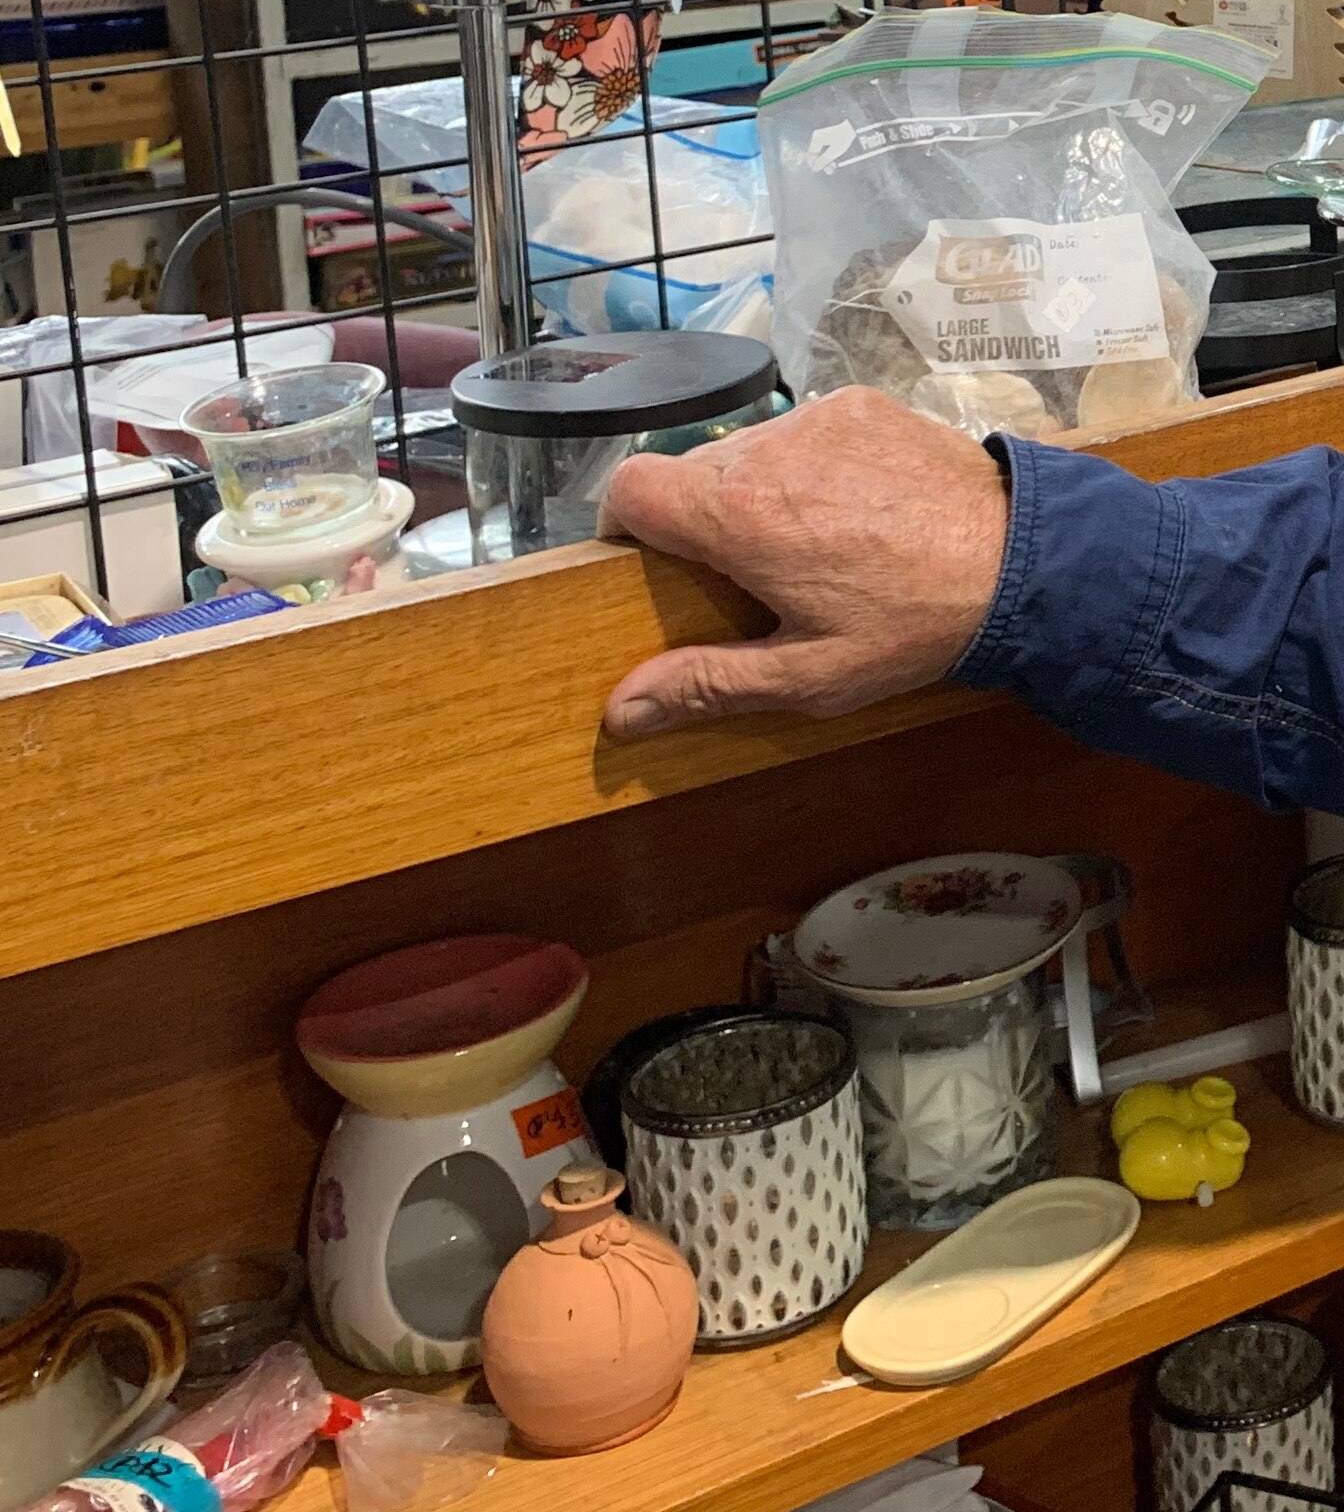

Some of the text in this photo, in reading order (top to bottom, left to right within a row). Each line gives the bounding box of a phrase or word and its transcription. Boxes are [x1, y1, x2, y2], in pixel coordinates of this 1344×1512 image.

[945, 239, 1042, 280] GLAD
[937, 318, 990, 338] LARGE
[937, 335, 1061, 363] SANDWICH
[280, 495, 317, 509] Home
